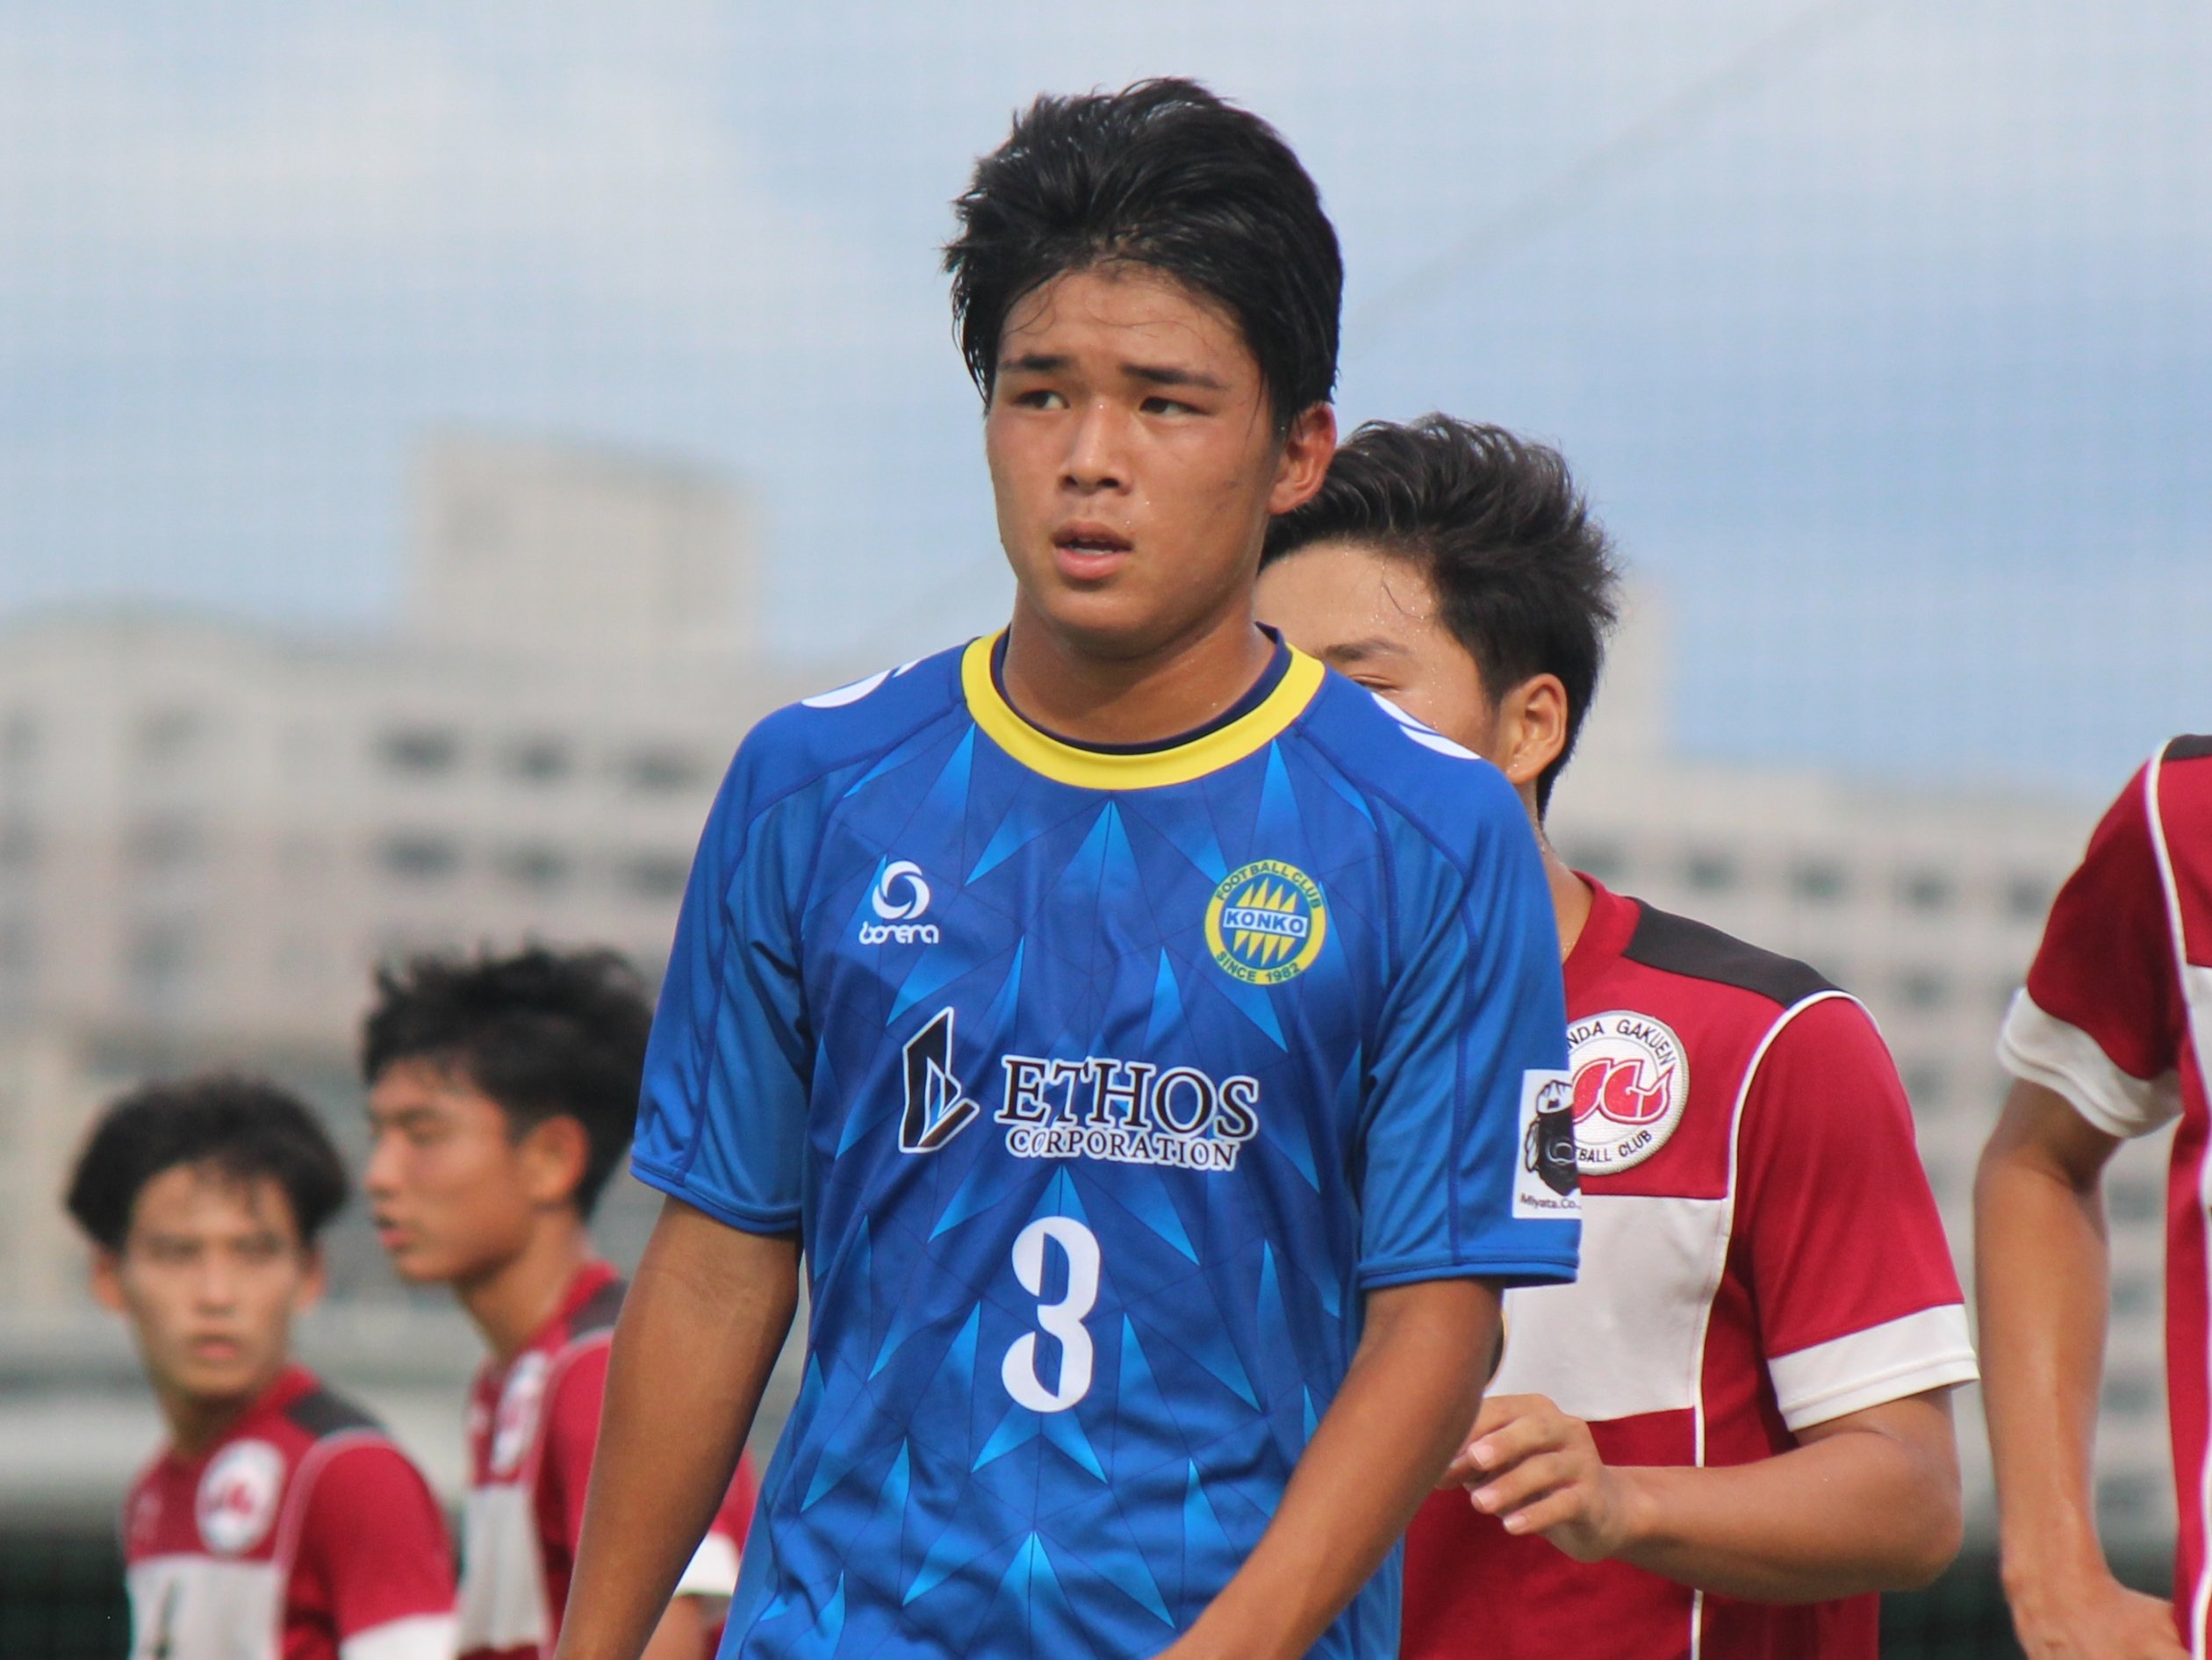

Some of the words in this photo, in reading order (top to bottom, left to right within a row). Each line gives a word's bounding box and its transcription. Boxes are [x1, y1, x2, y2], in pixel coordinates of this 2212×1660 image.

[1215, 861, 1289, 902] FOOTBALL
[1290, 872, 1322, 909] CLUB
[1226, 910, 1304, 934] KONKO
[1216, 950, 1258, 982] SINCE
[1265, 961, 1302, 983] 1982
[1616, 1019, 1676, 1066] GAKUEN
[994, 1054, 1260, 1141] ETHOS
[1006, 1126, 1240, 1170] CORPORATION
[1575, 1146, 1612, 1162] BALL
[1618, 1130, 1652, 1157] CLUB
[1002, 1216, 1101, 1413] 3
